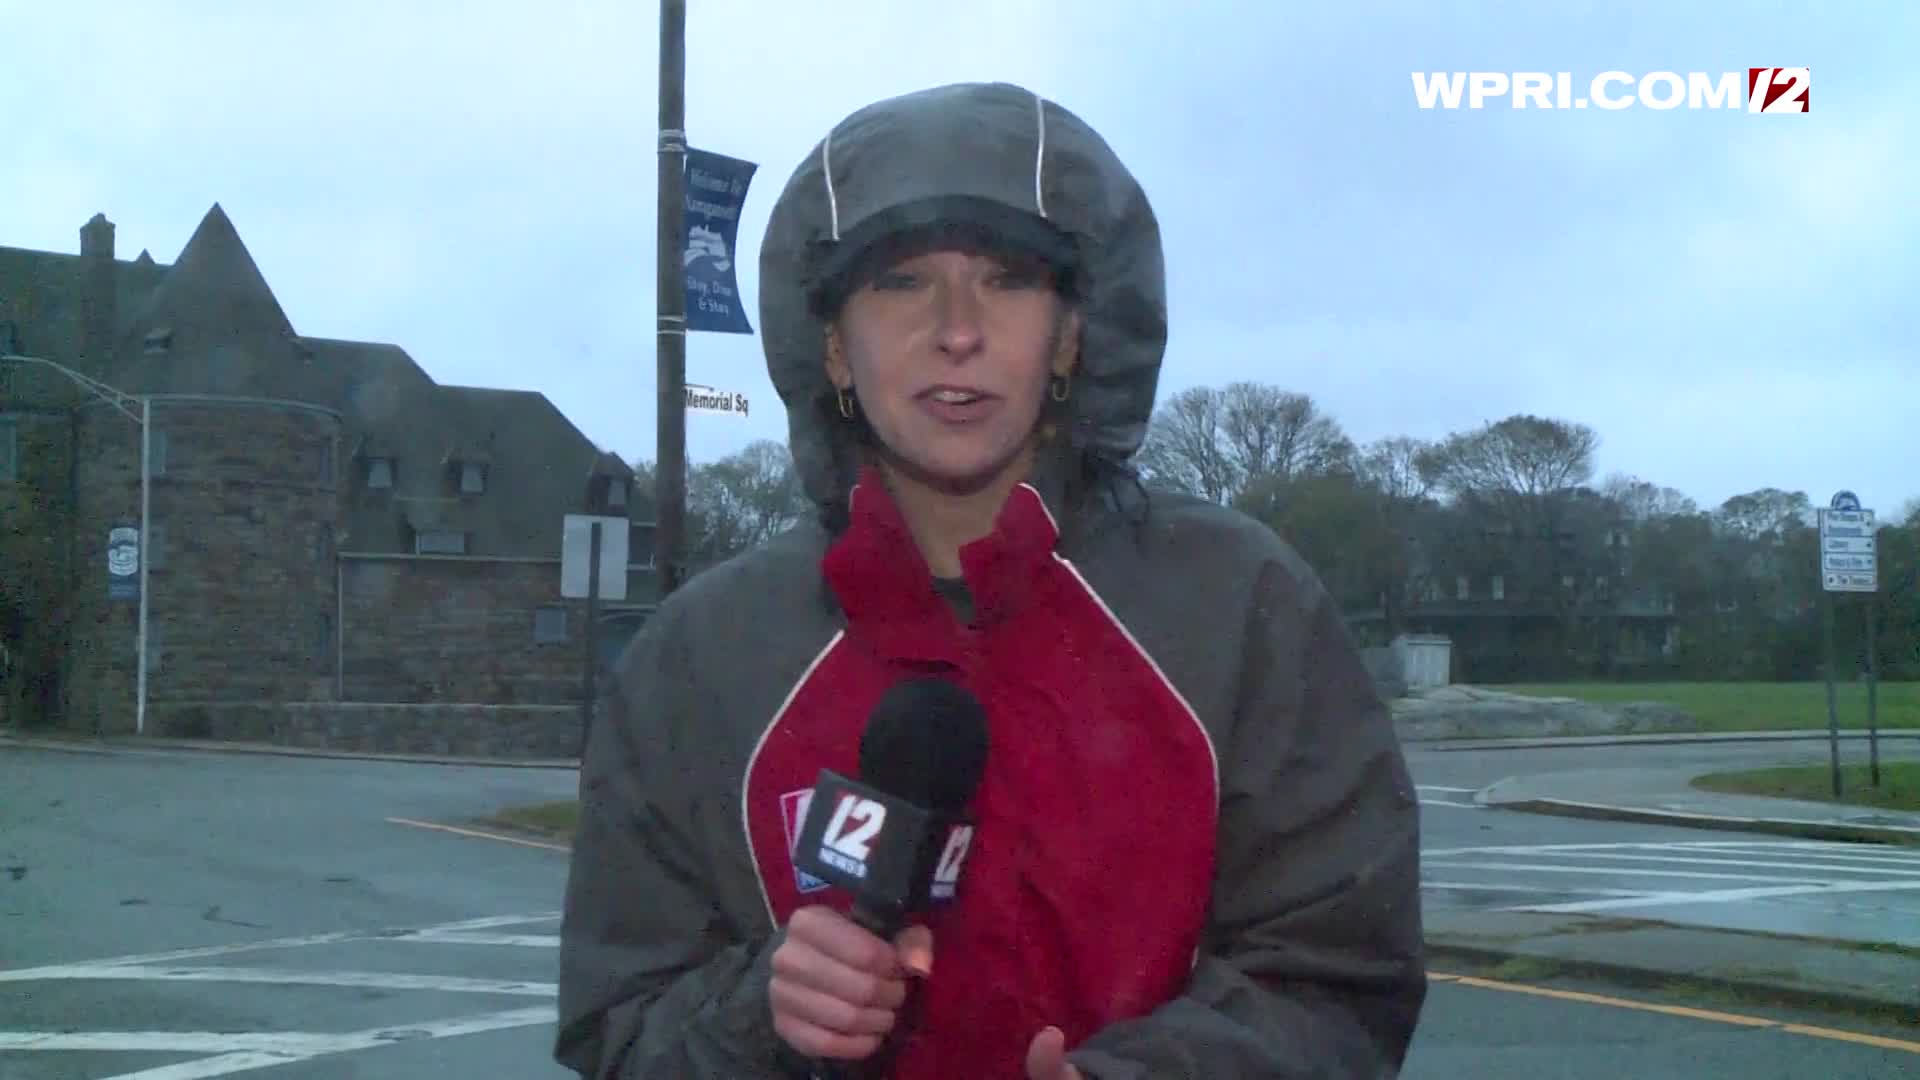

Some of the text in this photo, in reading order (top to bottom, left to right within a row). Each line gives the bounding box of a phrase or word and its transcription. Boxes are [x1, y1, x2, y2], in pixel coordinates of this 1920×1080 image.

[683, 389, 749, 417] Memorial Sq
[823, 794, 887, 862] 12
